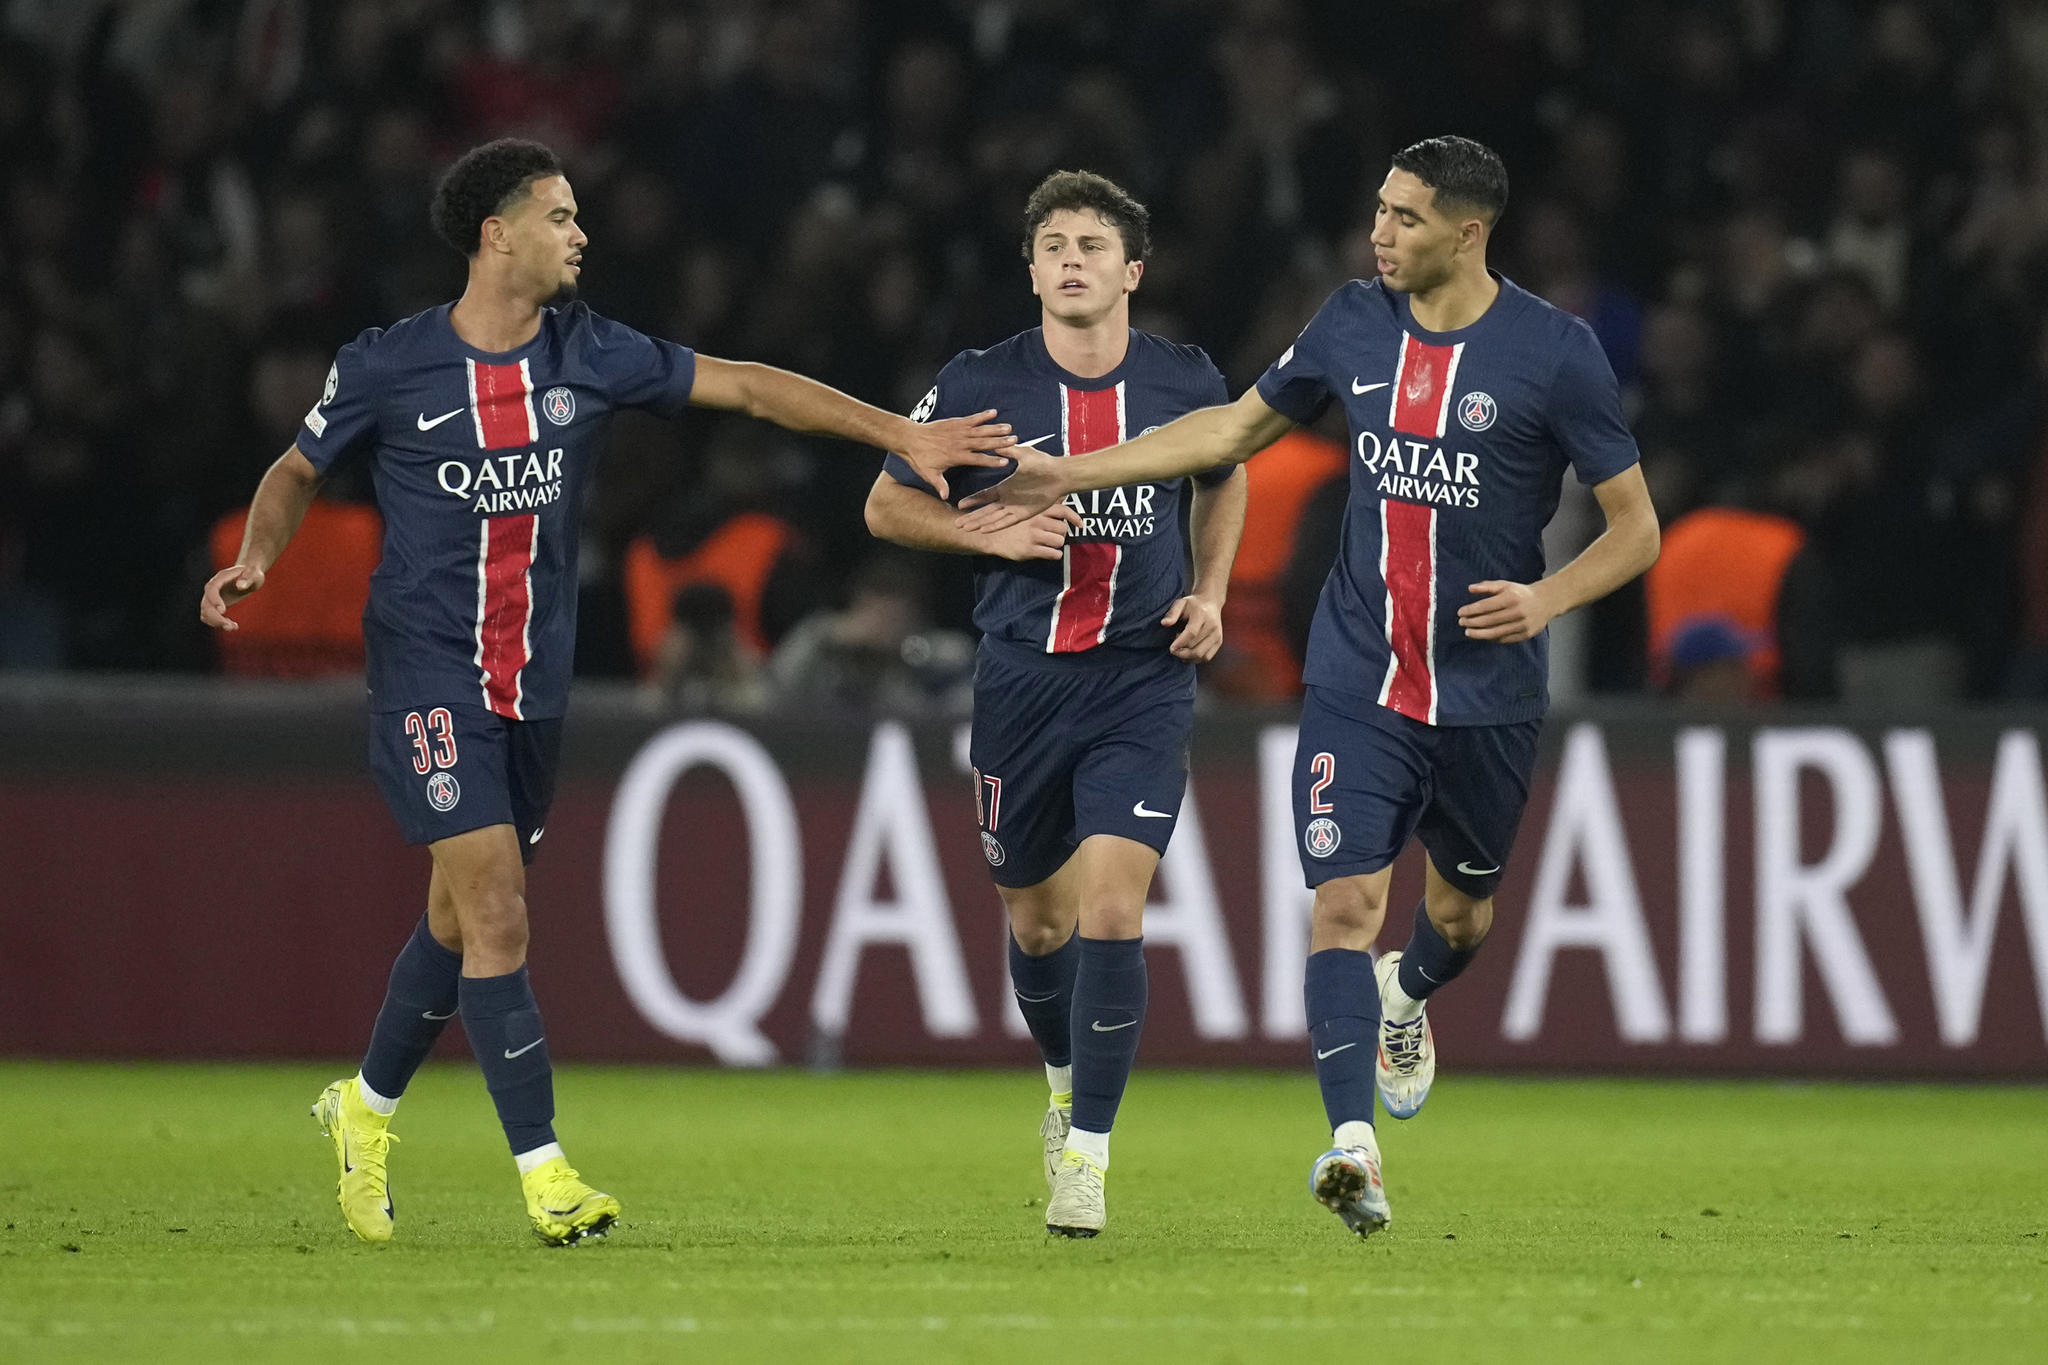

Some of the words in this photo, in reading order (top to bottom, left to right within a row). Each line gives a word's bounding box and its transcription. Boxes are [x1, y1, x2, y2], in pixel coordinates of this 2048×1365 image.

[546, 389, 569, 399] PARIS
[1467, 394, 1492, 406] PARIS
[437, 448, 563, 500] QATAR
[1358, 431, 1480, 485] QATAR
[472, 480, 562, 513] AIRWAYS
[1062, 485, 1155, 516] ATAR
[1376, 472, 1480, 508] AIRWAYS
[405, 707, 458, 775] 33
[429, 774, 451, 786] PARIS
[1310, 752, 1335, 814] 2
[1309, 820, 1333, 831] PARIS
